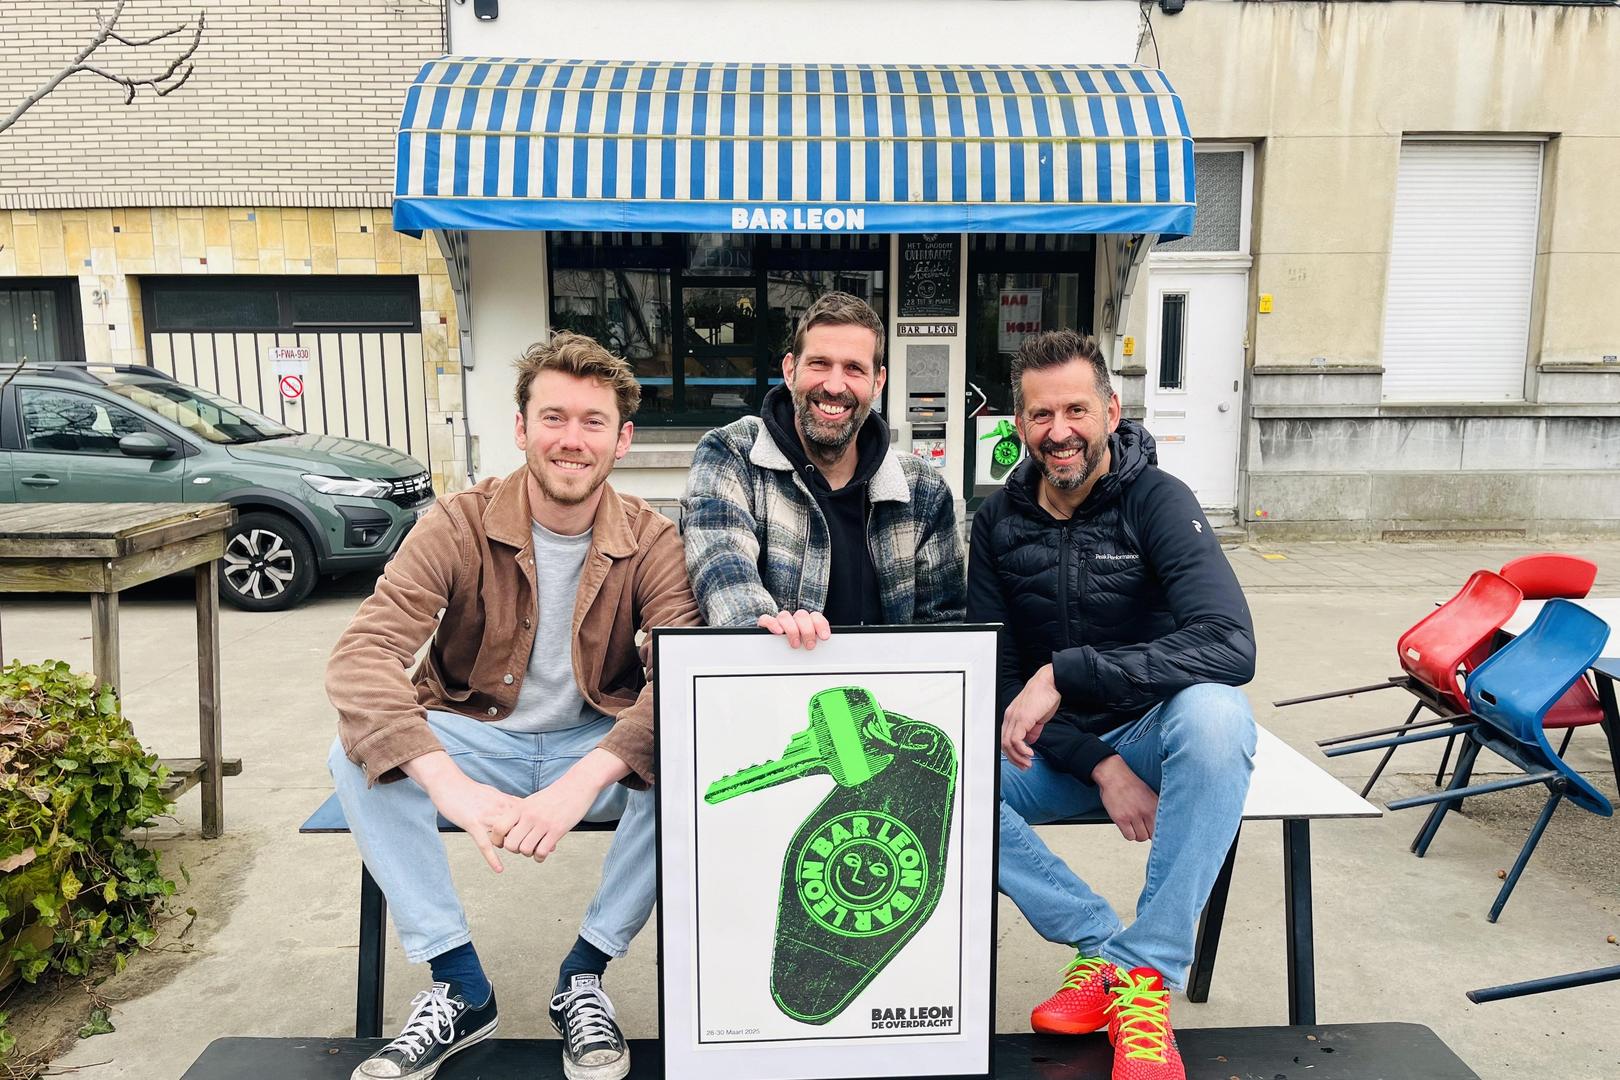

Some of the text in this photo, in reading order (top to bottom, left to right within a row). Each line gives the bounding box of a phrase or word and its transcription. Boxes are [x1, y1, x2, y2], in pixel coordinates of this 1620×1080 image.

[731, 207, 865, 231] BAR LEON
[92, 289, 110, 305] 21
[901, 325, 954, 334] BAR LEON
[275, 350, 309, 359] 1-FWA-930
[802, 817, 922, 931] BAR LEON BAR LEON
[871, 1006, 953, 1021] BAR LEON
[872, 1019, 953, 1029] DE OVERDRACHT
